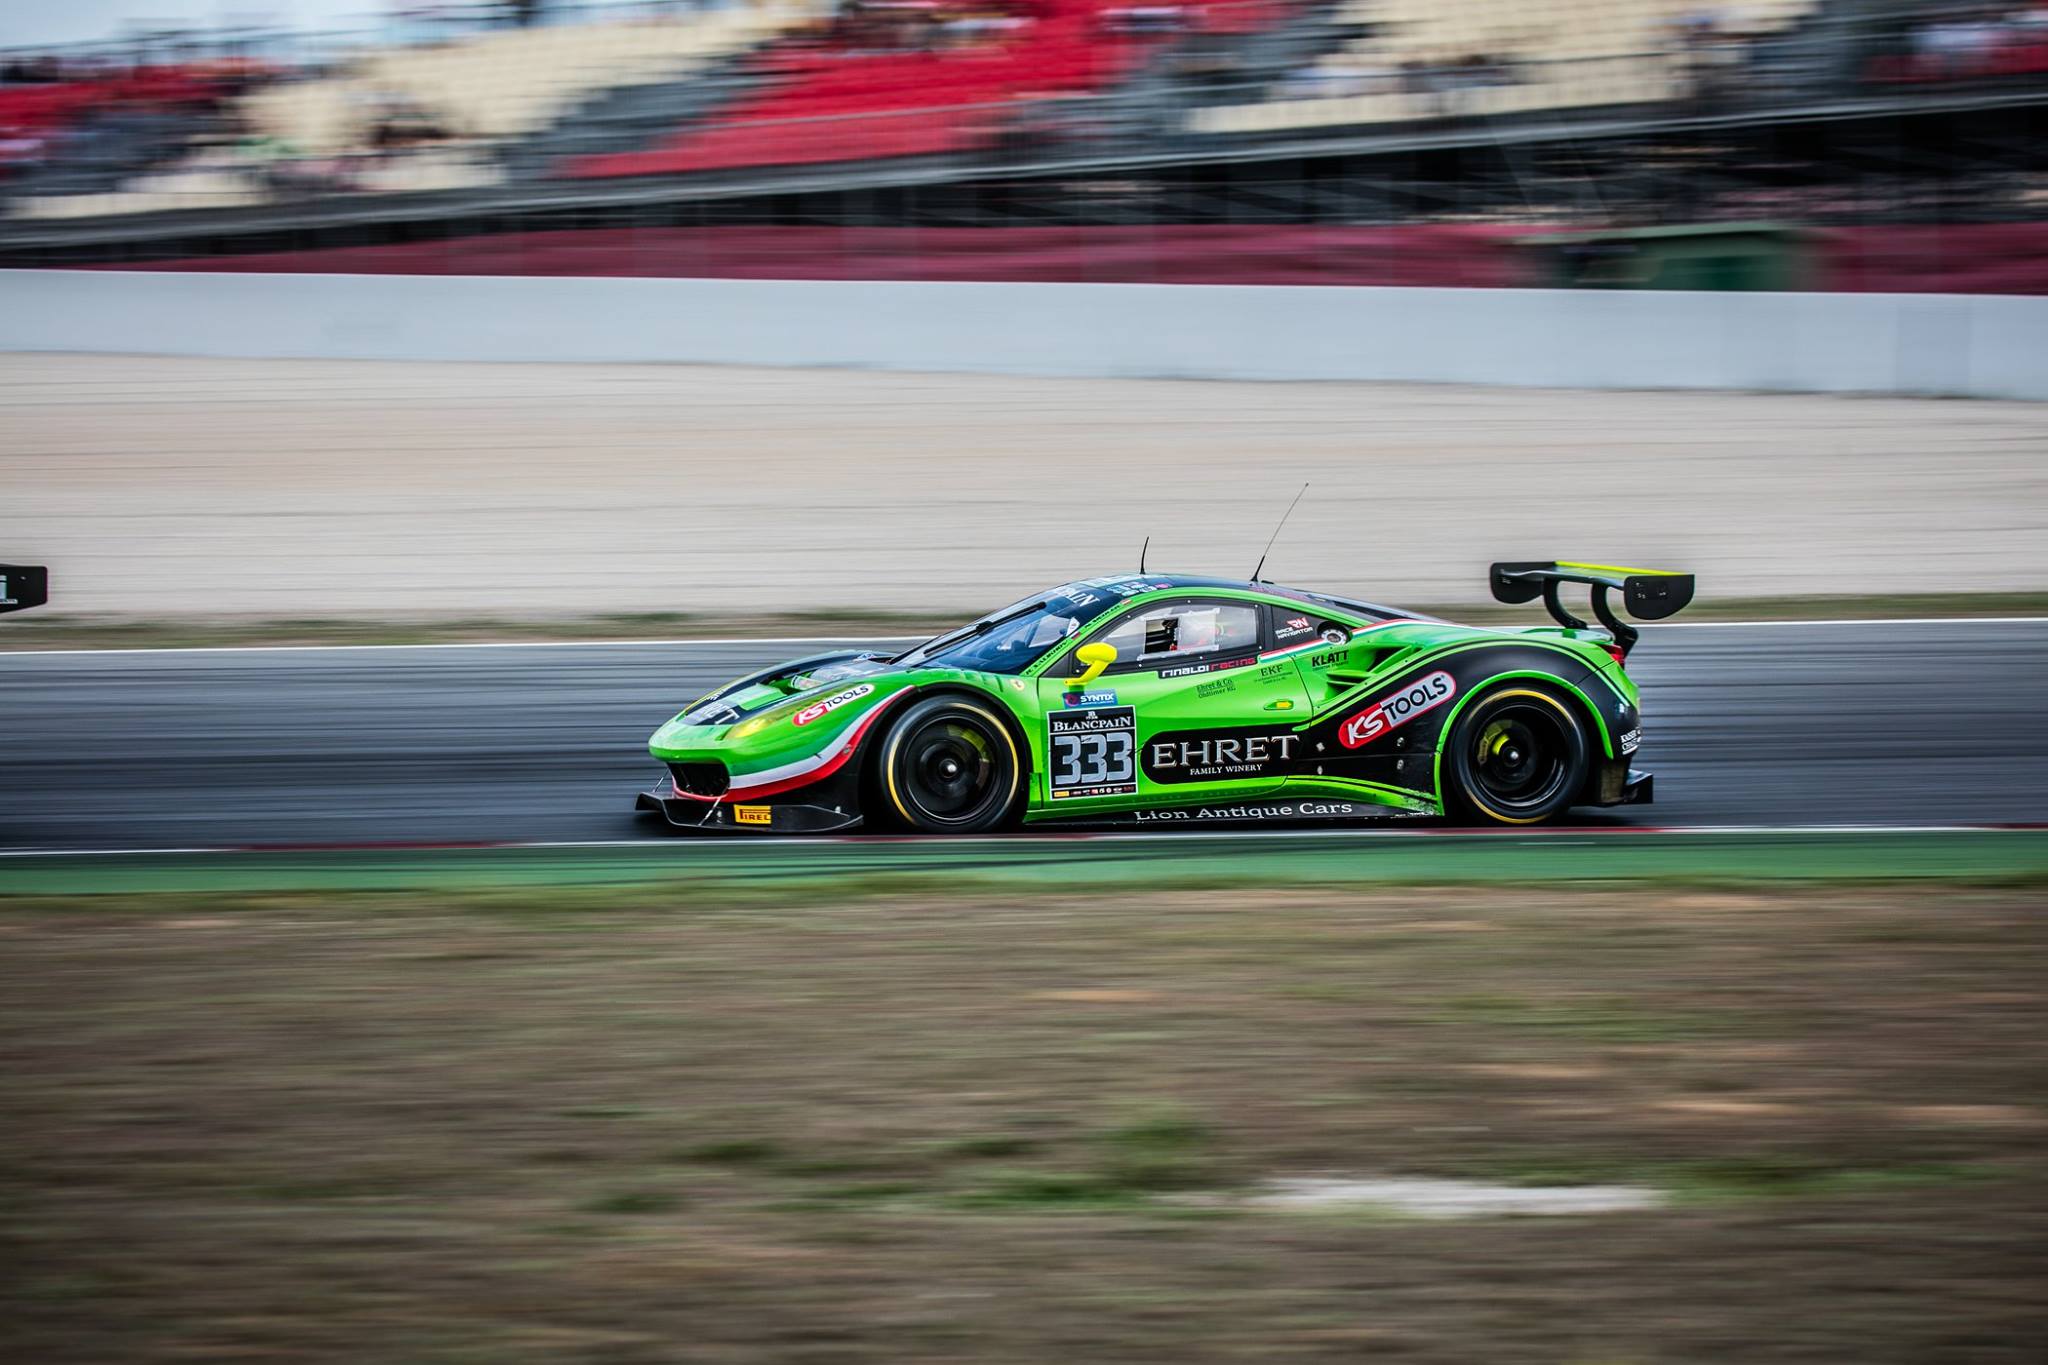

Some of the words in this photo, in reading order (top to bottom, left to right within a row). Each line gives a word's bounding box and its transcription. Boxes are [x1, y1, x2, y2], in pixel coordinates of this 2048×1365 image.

[1312, 650, 1349, 667] KLATT
[1260, 664, 1283, 677] EKF
[798, 703, 825, 724] KS
[824, 685, 869, 708] TOOLS
[1080, 693, 1114, 703] SYNTIX
[1347, 708, 1384, 745] KS
[1382, 677, 1447, 720] TOOLS
[1053, 716, 1132, 732] BLANCPAIN
[1054, 732, 1133, 785] 333
[1152, 735, 1300, 769] EHRET
[1189, 766, 1223, 776] FAMILY
[1225, 763, 1263, 773] WINERY
[1134, 811, 1190, 821] Lion
[1196, 806, 1293, 819] Antique
[1299, 803, 1353, 815] Cars
